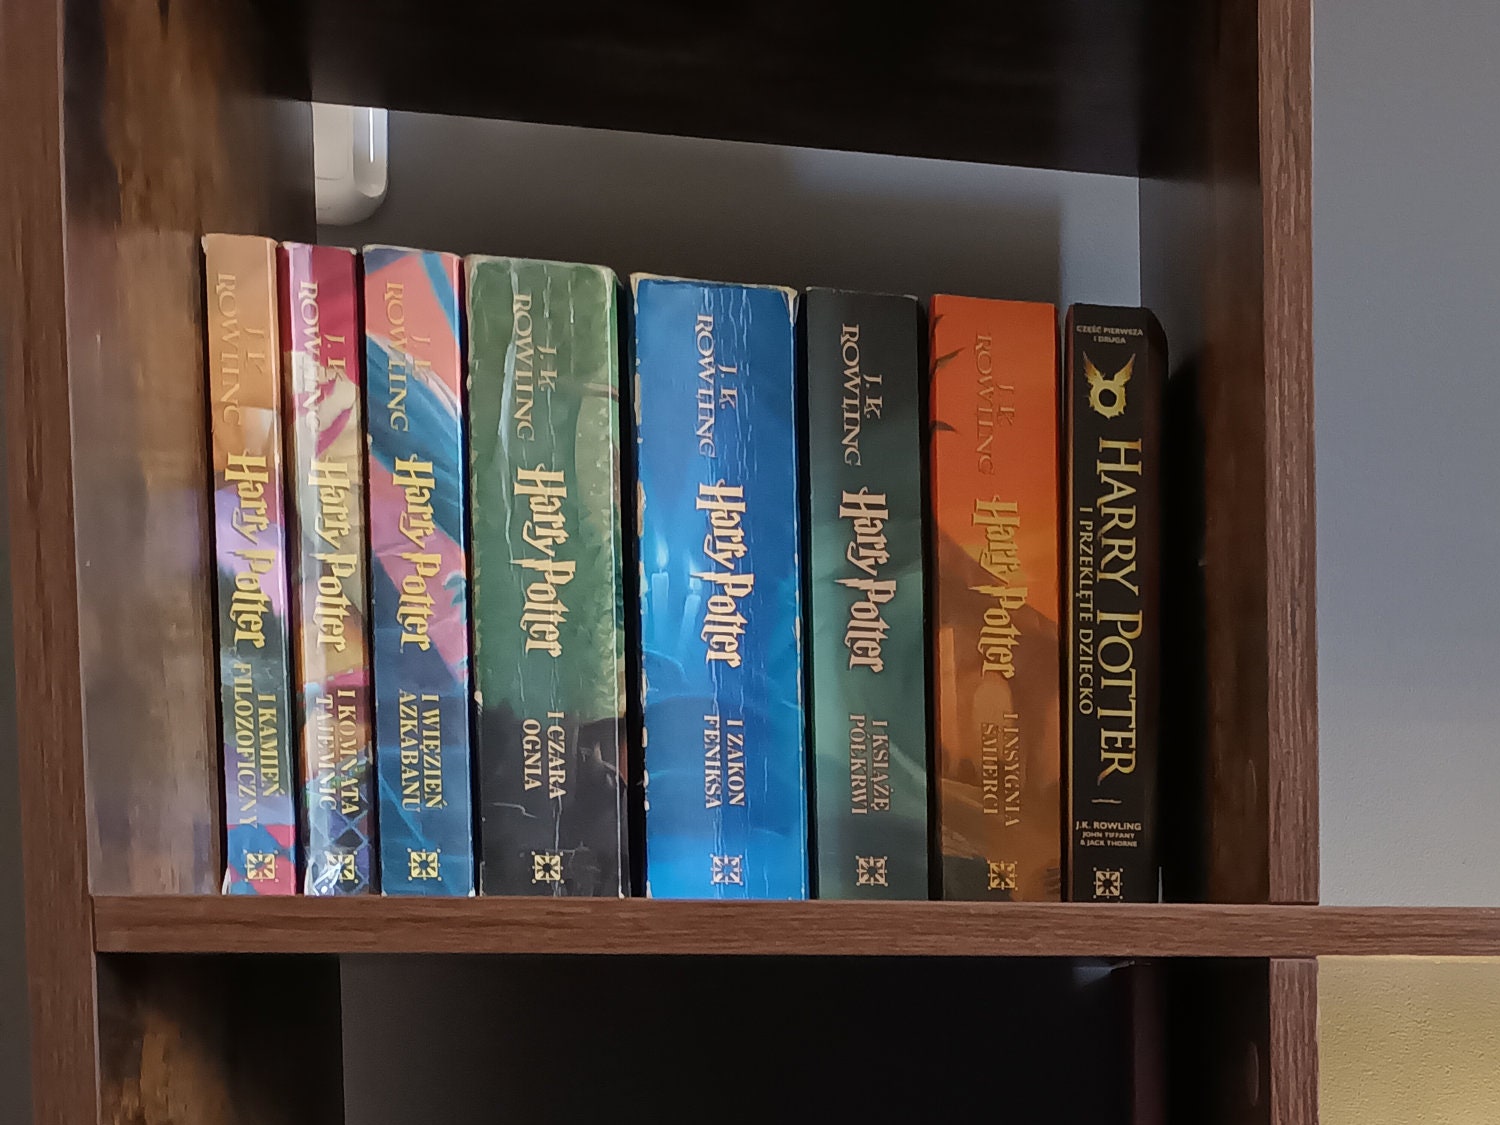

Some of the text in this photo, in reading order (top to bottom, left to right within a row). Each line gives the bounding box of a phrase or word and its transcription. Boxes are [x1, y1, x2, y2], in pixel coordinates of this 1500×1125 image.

[216, 273, 241, 426] ROWLING
[385, 281, 409, 432] ROWLING
[512, 292, 535, 441] ROWLING
[694, 314, 716, 458] ROWLING
[840, 323, 862, 466] ROWLING
[1098, 336, 1127, 344] DRUGA
[975, 335, 995, 476] ROWLING
[224, 451, 275, 652] Harry Potter
[308, 456, 357, 652] Harry Potter
[393, 453, 442, 653] Harry Potter
[511, 463, 576, 658] Harry Potter
[691, 479, 754, 668] Harry Potter
[834, 486, 896, 673] Harry Potter
[968, 495, 1028, 679] Harry Potter
[1076, 520, 1094, 622] PRZEKLĘTE
[1096, 436, 1143, 785] HARRY POTTER
[1079, 628, 1094, 715] DZIECKO
[234, 663, 258, 829] FILOZOFICZNY
[259, 707, 285, 797] KAMIEŃ
[316, 694, 336, 811] TAJEMNIC
[338, 690, 359, 814] I KOMNATA
[399, 689, 421, 812] AZKABANU
[421, 694, 448, 810] I WIĘZIEŃ
[522, 718, 543, 791] OGNIA
[547, 711, 567, 800] I CZARA
[704, 714, 722, 809] FENIKSA
[726, 719, 745, 807] I ZAKON
[850, 714, 871, 814] PÓŁKRWI
[870, 734, 894, 811] KSIĄŻĘ
[1004, 727, 1020, 826] INSYGNIA
[1082, 831, 1103, 839] JOHN
[1093, 821, 1142, 831] ROWLING
